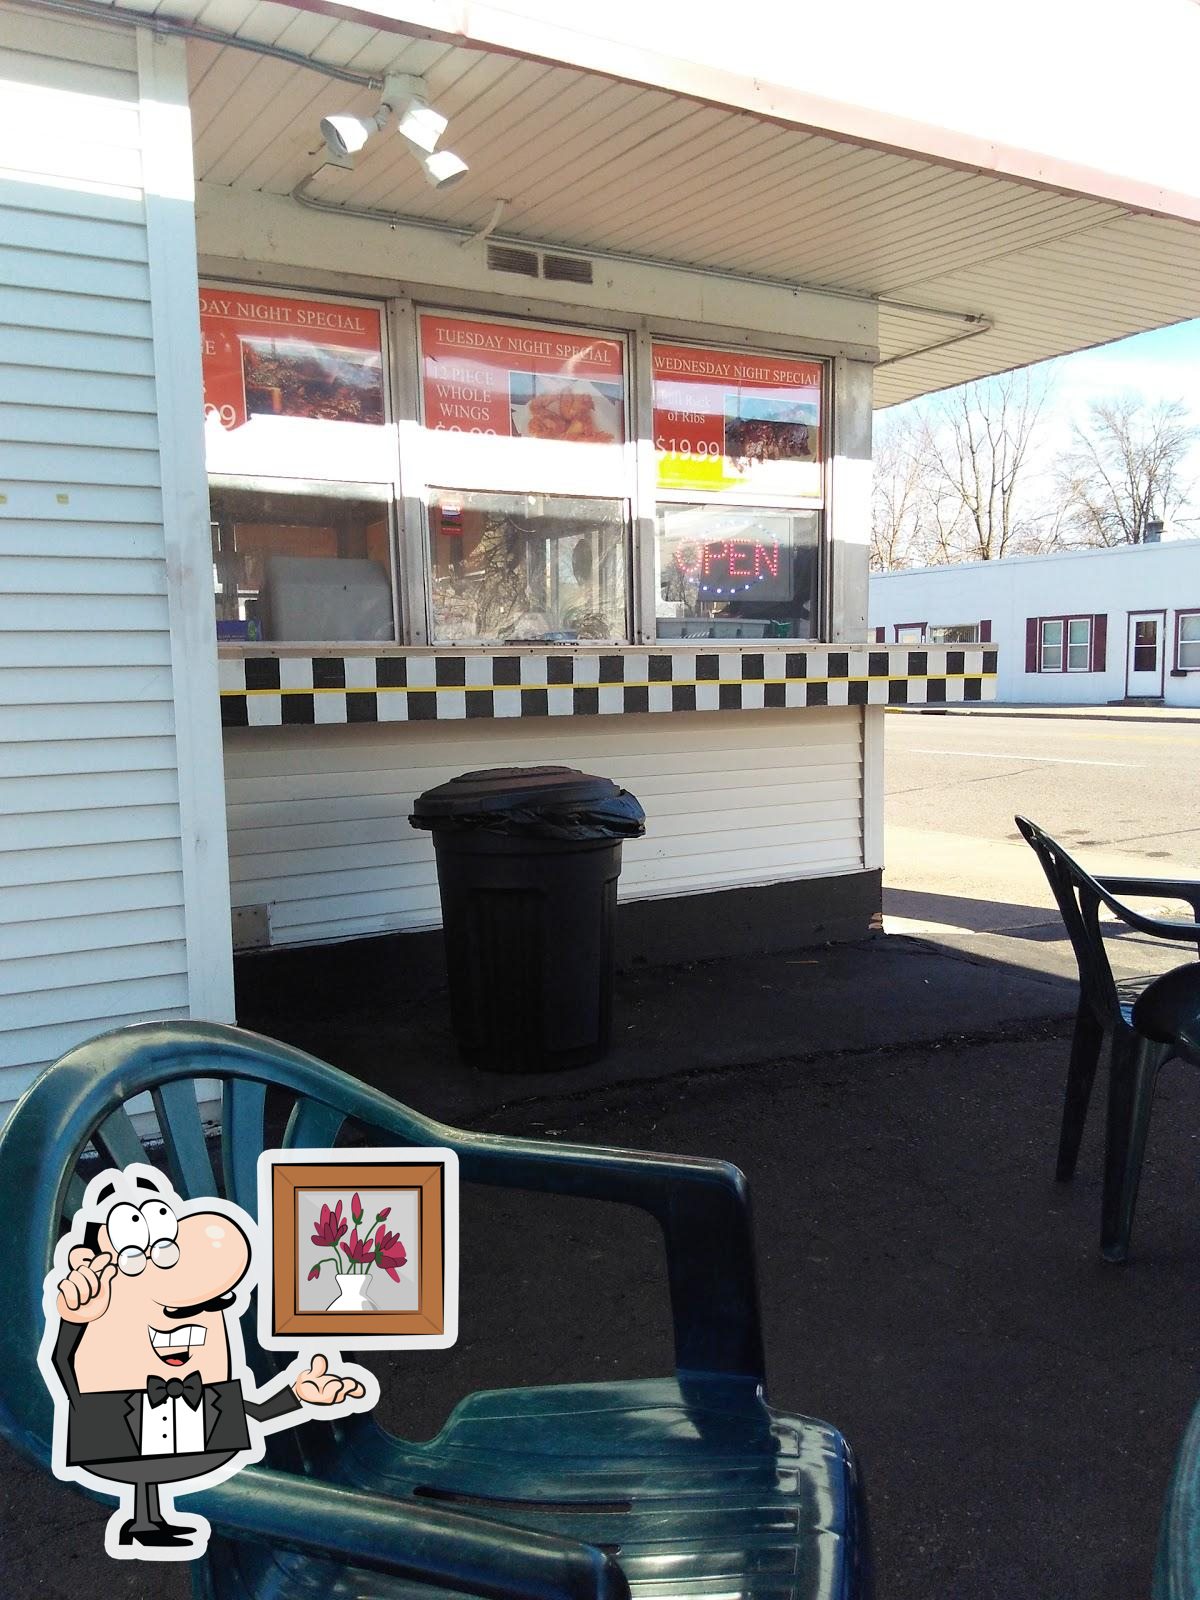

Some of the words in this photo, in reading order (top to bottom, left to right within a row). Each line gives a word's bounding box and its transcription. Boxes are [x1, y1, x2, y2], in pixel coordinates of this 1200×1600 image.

[236, 303, 292, 321] NIGHT
[297, 310, 366, 331] SPECIAL
[436, 328, 503, 349] TUESDAY
[508, 338, 556, 355] NIGHT
[556, 344, 612, 363] SPECIAL
[452, 367, 496, 386] PIECE
[654, 357, 731, 376] WEDNESDAY
[734, 365, 771, 381] NIGHT
[773, 370, 819, 386] SPECIAL
[436, 384, 493, 404] WHOLE
[439, 402, 490, 421] WINGS
[682, 411, 706, 424] Ribs
[655, 435, 721, 463] $19.99
[675, 537, 779, 577] OPEN
